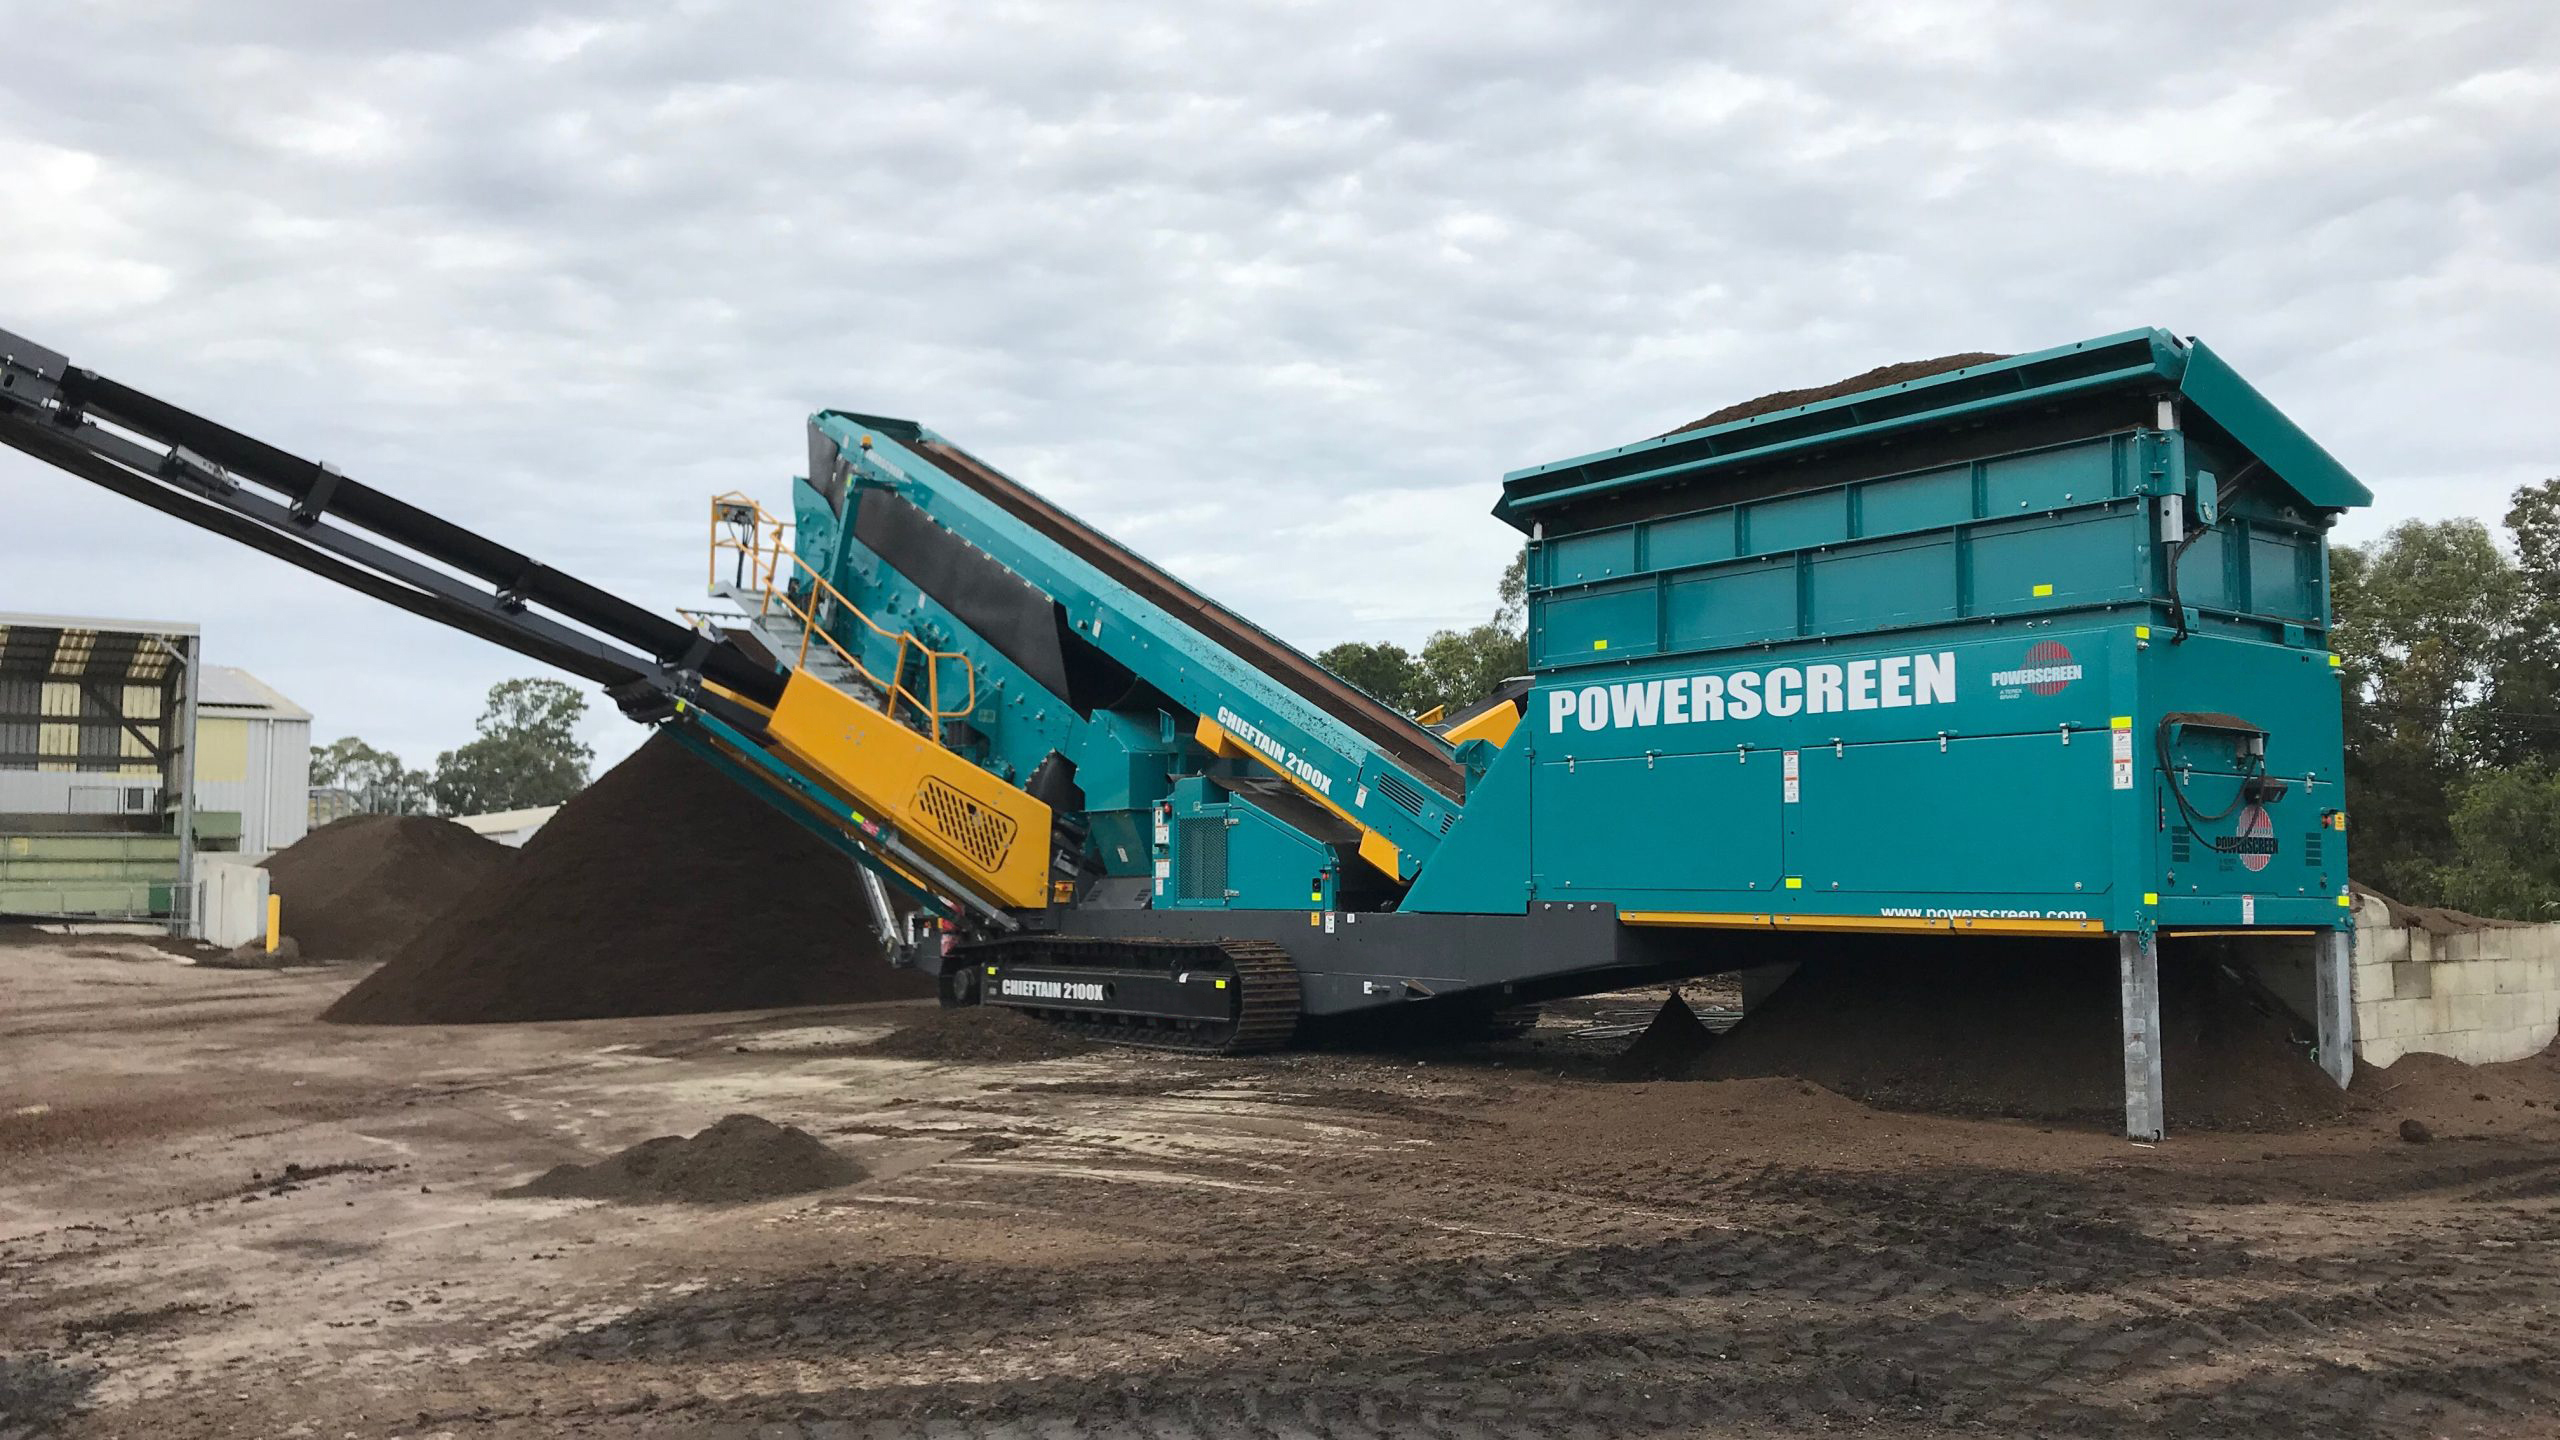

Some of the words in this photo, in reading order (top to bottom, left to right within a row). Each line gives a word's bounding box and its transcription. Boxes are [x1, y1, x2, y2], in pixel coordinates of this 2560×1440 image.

[1992, 665, 2082, 686] POWERSCREEN
[1549, 651, 1957, 734] POWERSCREEN
[1217, 705, 1286, 763] CHIEFTAIN
[1285, 751, 1333, 796] 2100X
[1881, 908, 2087, 919] wwwpowerscreencom
[1002, 978, 1062, 998] CHIEFTAIN
[1063, 982, 1104, 1001] 2100X
